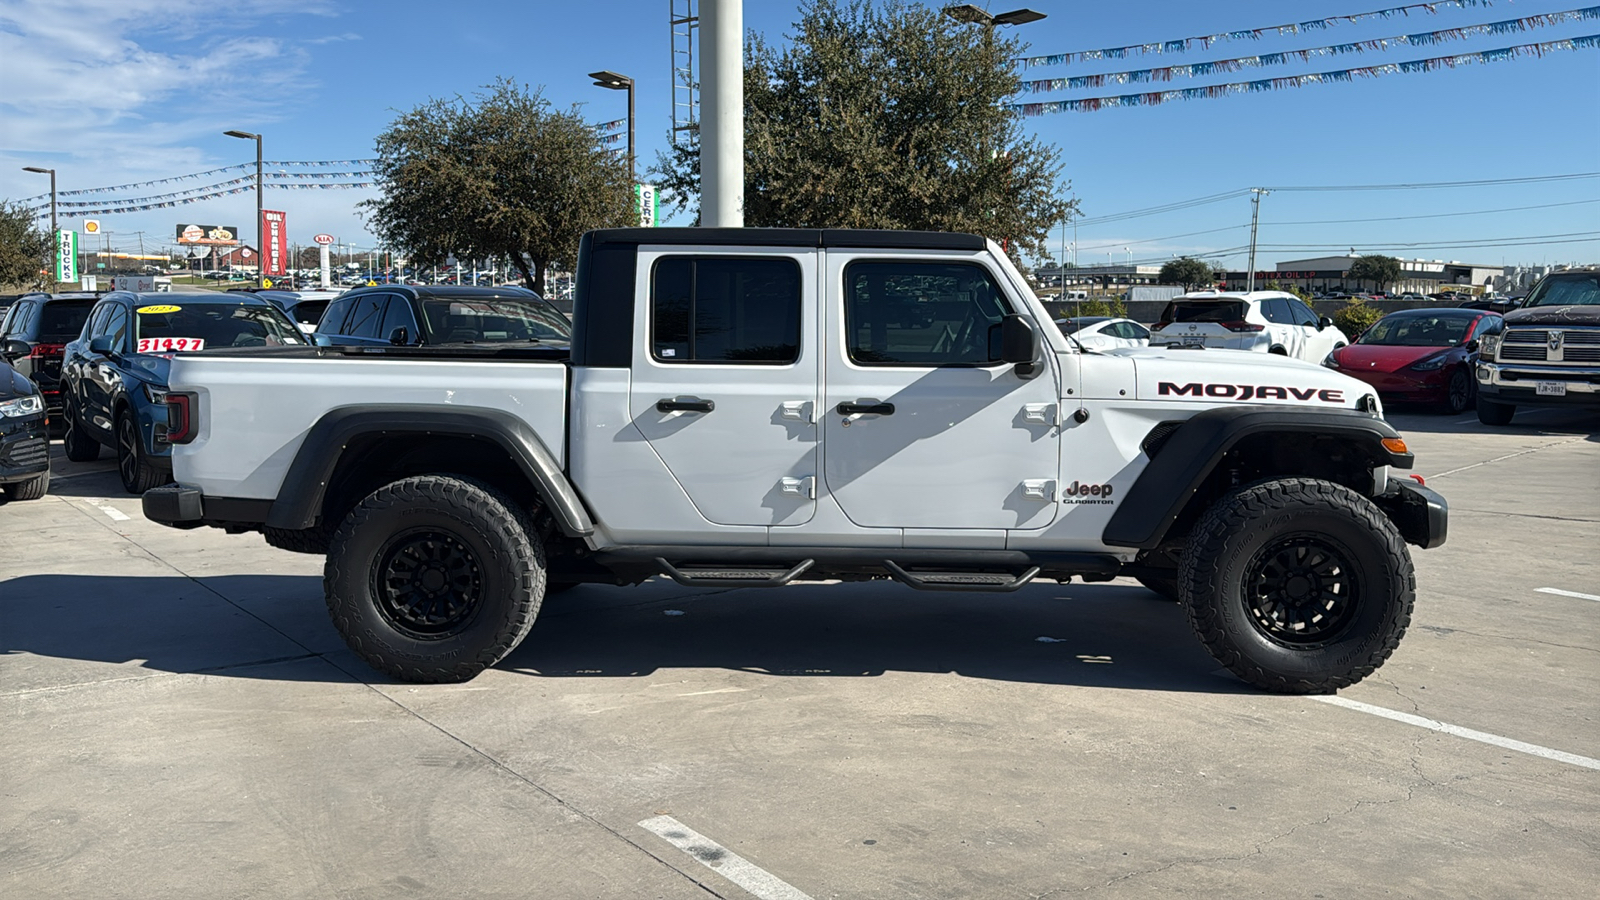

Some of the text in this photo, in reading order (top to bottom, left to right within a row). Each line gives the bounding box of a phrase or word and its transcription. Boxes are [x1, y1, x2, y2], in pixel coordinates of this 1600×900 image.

[266, 212, 282, 222] OIL
[63, 233, 71, 279] TRUCKS
[271, 222, 279, 272] CHANGES
[1286, 271, 1300, 279] OIL
[139, 339, 202, 352] 31497
[1158, 382, 1346, 403] MOJAVE
[1067, 480, 1113, 498] Jeep
